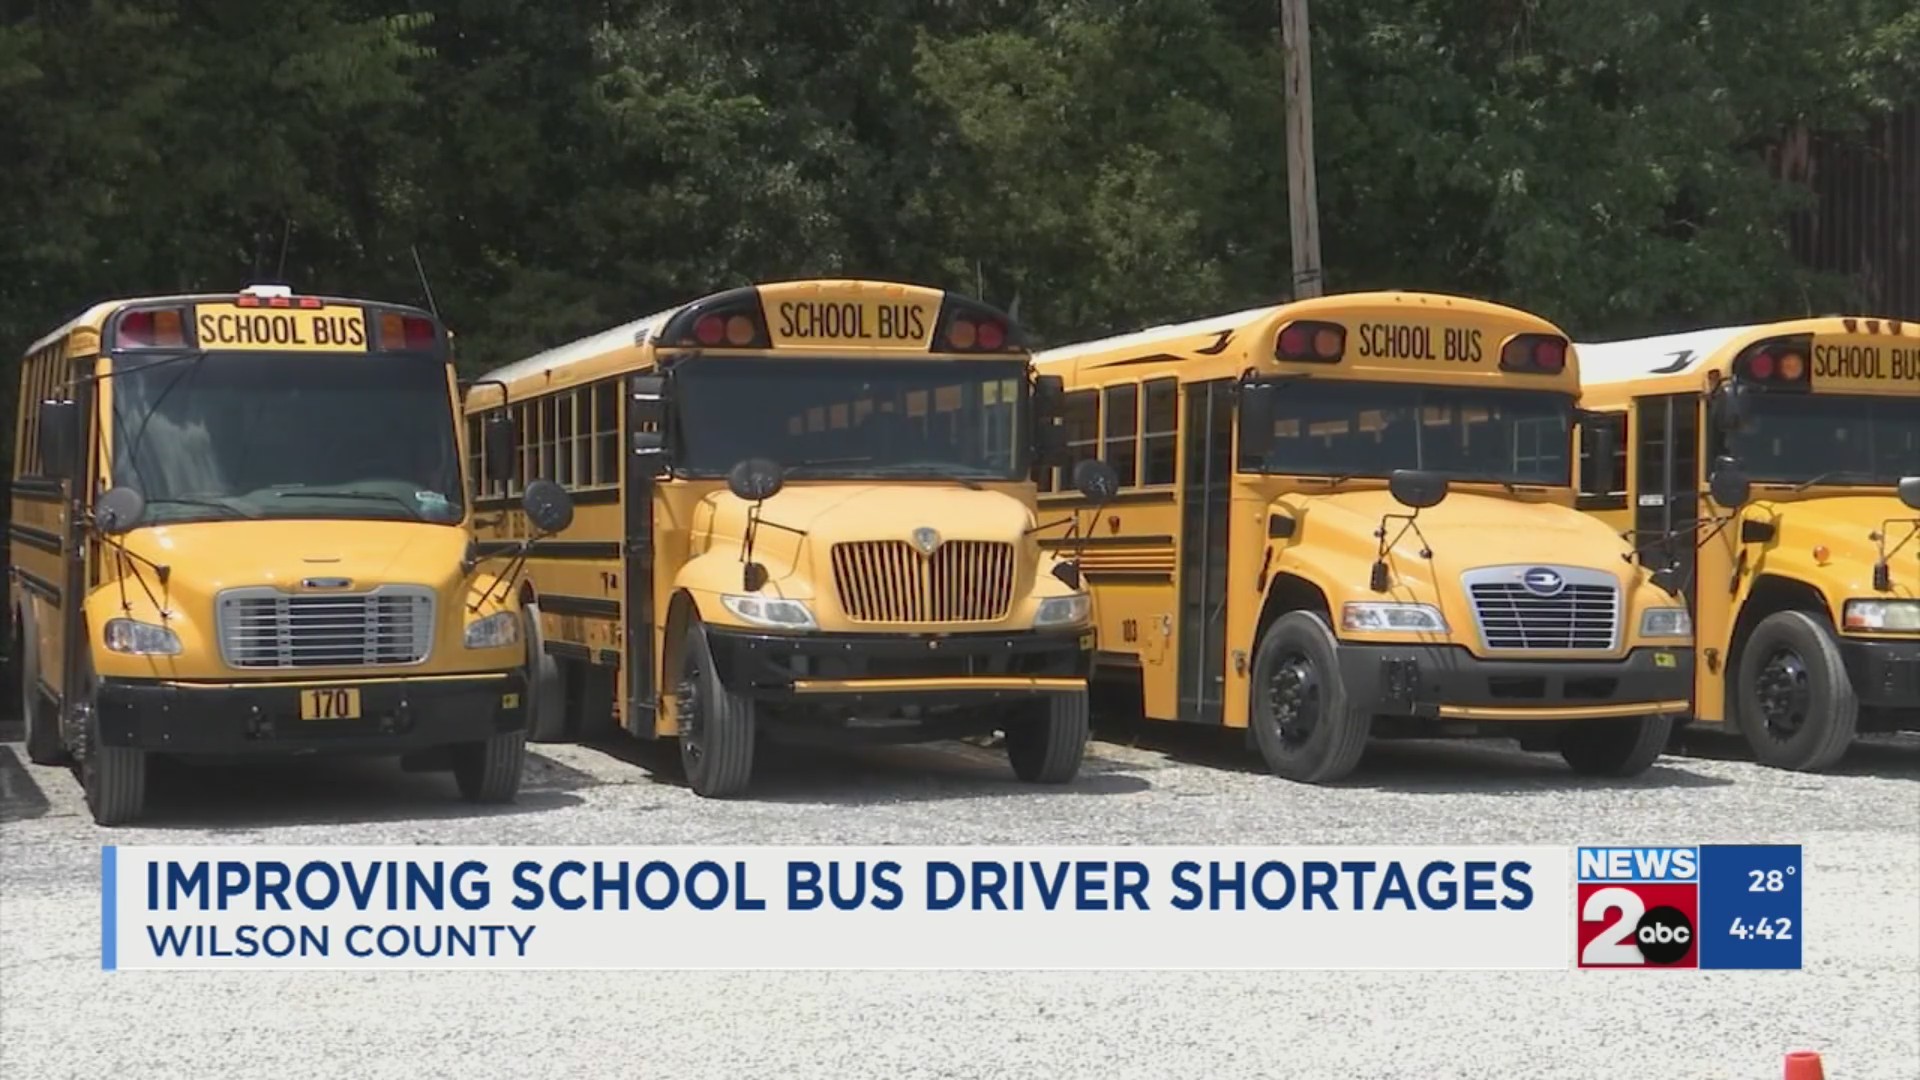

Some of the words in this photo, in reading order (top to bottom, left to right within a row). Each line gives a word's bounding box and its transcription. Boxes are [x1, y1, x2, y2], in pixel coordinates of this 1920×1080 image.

[200, 314, 306, 344] SCHOOL
[312, 316, 363, 346] BUS
[780, 302, 872, 339] SCHOOL
[878, 304, 925, 340] BUS
[1359, 323, 1436, 361] SCHOOL
[1444, 327, 1482, 363] BUS
[1814, 345, 1887, 379] SCHOOL
[312, 690, 349, 718] 170
